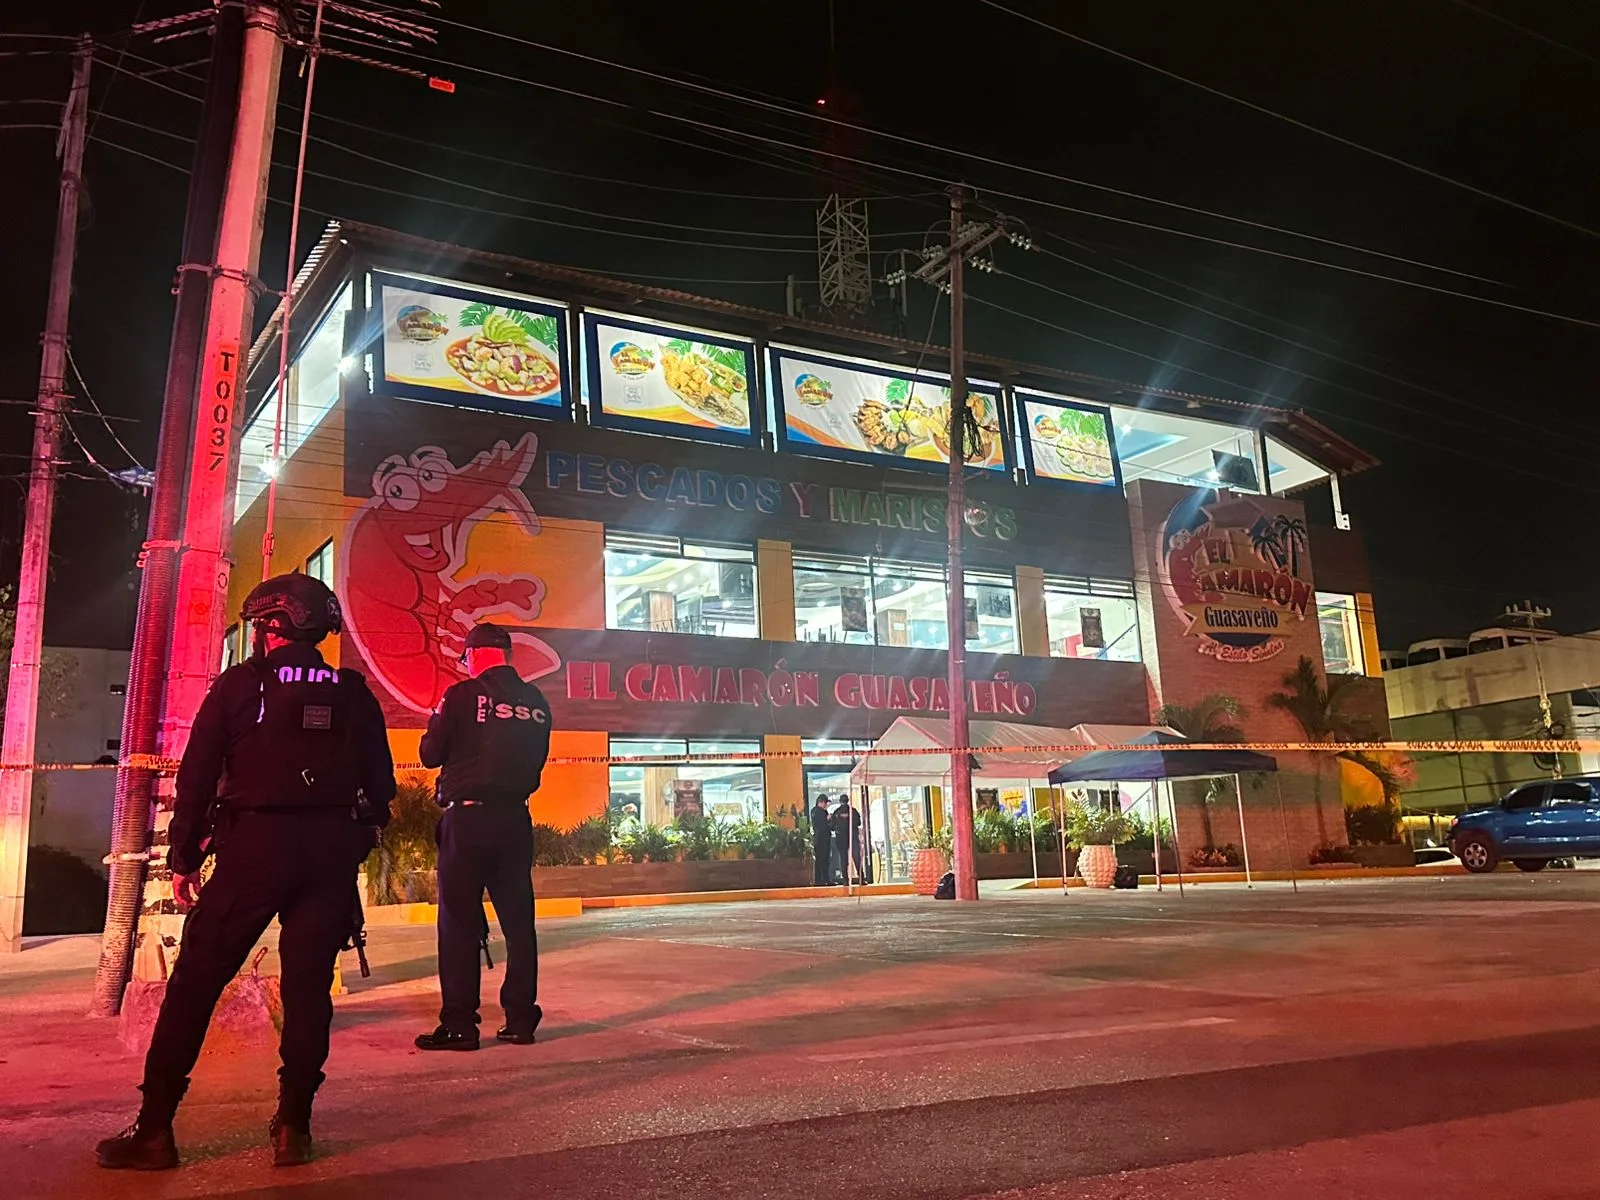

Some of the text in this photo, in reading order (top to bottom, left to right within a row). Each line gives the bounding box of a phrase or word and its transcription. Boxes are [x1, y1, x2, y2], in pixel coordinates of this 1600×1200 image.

[209, 351, 235, 471] T0037
[545, 451, 1018, 540] PESCADOS Y MARISOS
[1204, 605, 1279, 629] Guasaveño
[495, 703, 546, 724] SSC
[566, 657, 1037, 716] EL CAMARÓN GUASAEÑO
